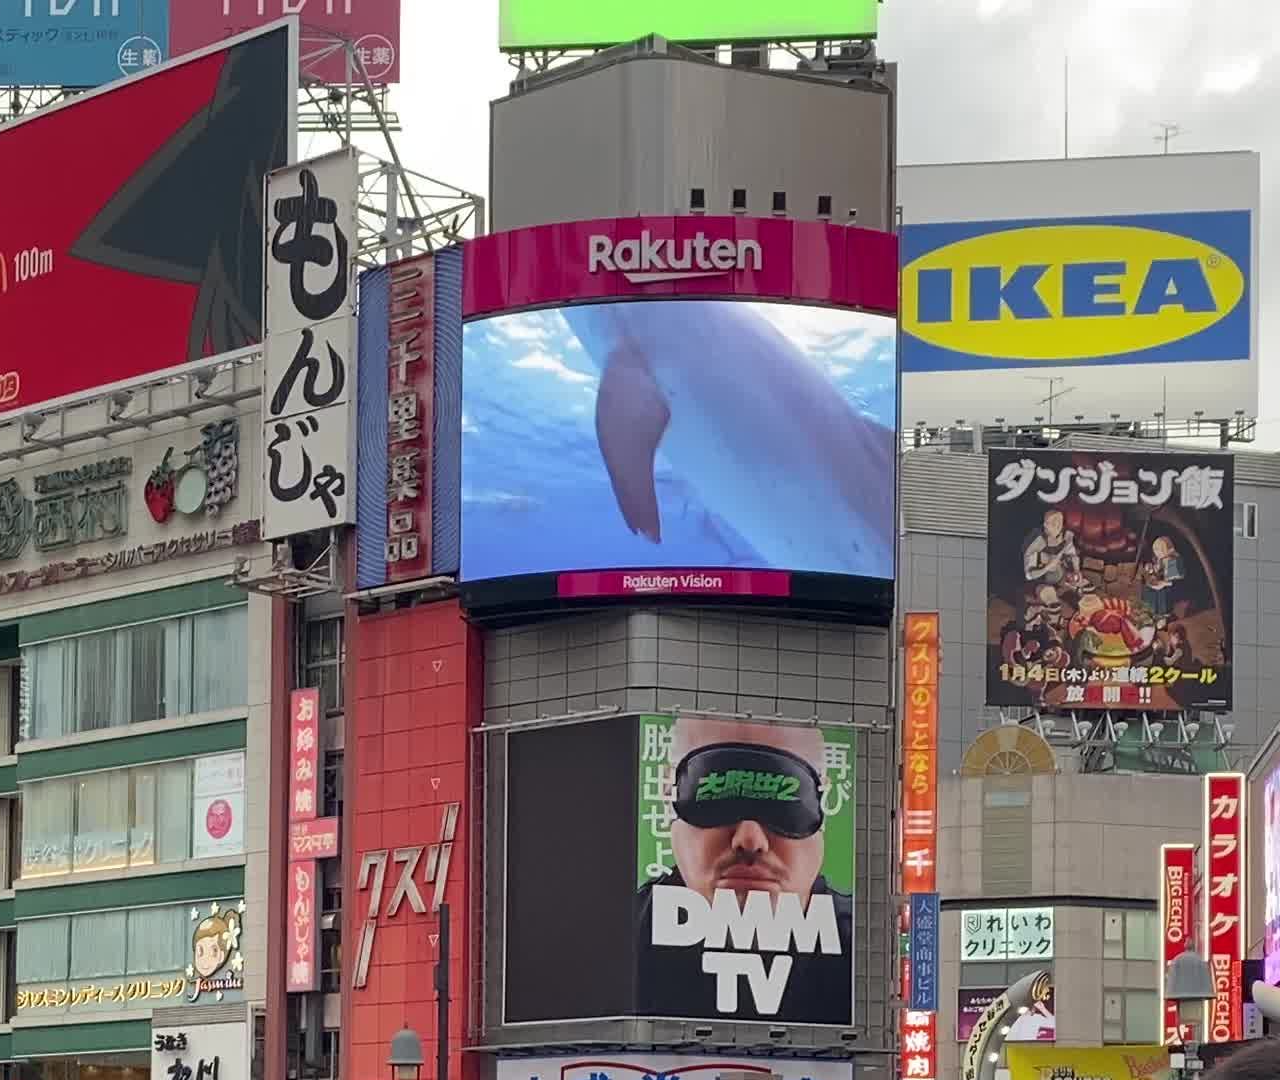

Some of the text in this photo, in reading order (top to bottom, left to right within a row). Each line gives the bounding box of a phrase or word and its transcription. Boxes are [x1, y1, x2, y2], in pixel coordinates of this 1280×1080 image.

[121, 48, 160, 67] 生薬
[14, 246, 54, 282] 100m
[588, 230, 763, 275] Rakuten
[917, 257, 1219, 325] IKEA
[270, 168, 349, 518] もんじゃ
[385, 266, 424, 562] 三千里薬品
[995, 458, 1224, 510] ダンジョン飯
[623, 573, 723, 591] Rakuten Vision
[642, 723, 678, 879] 脱出せよ
[906, 808, 933, 878] 三千
[1209, 794, 1241, 938] カラオケ
[651, 884, 842, 955] DMM
[985, 913, 1053, 933] れいわ
[1167, 865, 1184, 943] BIG ECHO
[964, 937, 1052, 957] クリニック
[701, 950, 794, 1016] TV
[1212, 953, 1231, 1043] BIG ECHO
[154, 1032, 188, 1052] うなぎ
